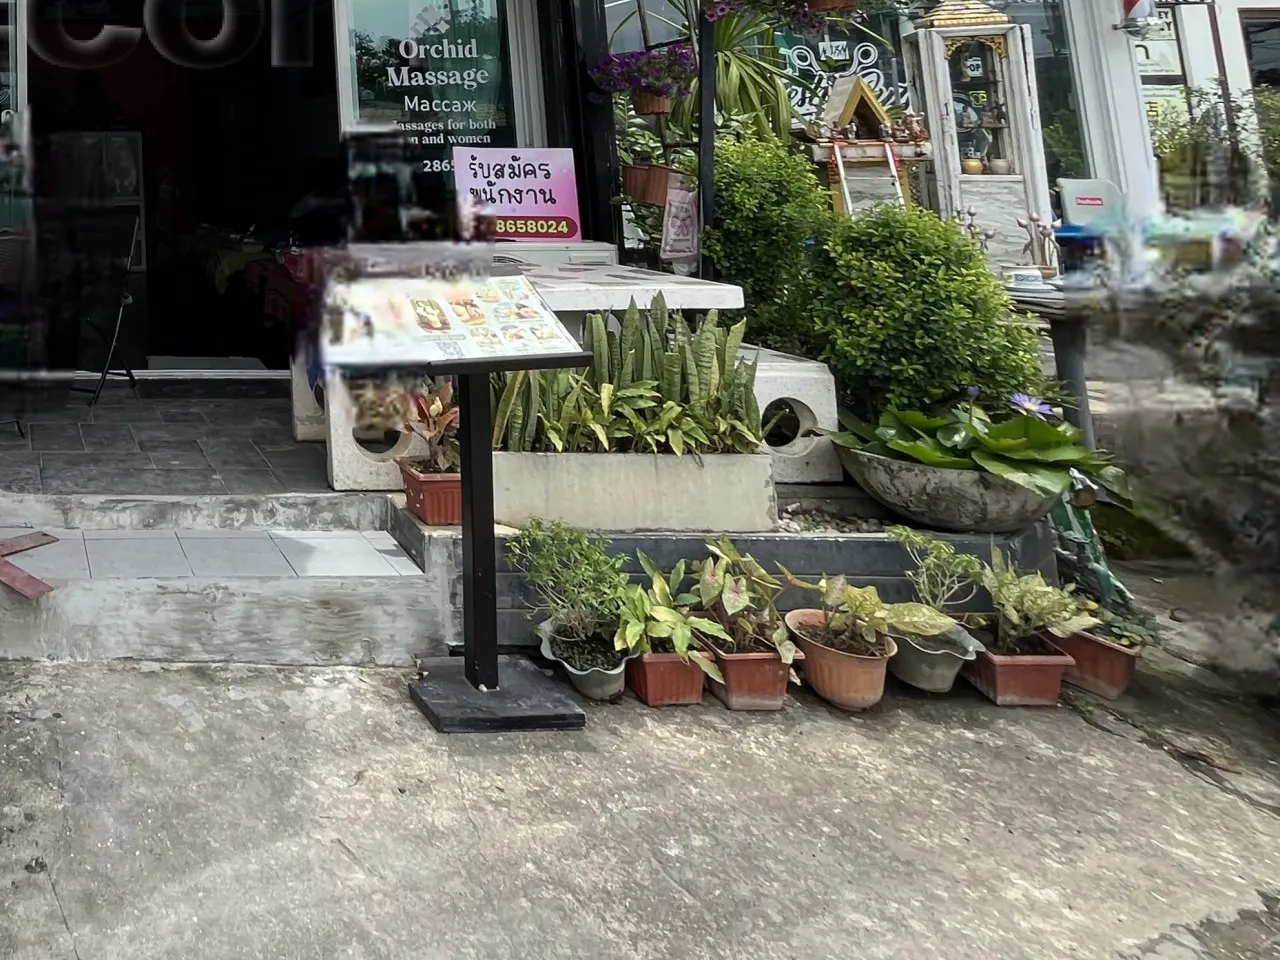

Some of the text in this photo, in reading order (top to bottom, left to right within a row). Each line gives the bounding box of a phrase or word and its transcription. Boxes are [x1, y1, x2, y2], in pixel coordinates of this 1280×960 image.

[398, 38, 478, 60] Orchid
[385, 66, 490, 91] Massage
[404, 94, 478, 113] Массаж
[393, 118, 497, 133] assages for both
[421, 133, 445, 145] and
[446, 135, 492, 145] women
[468, 154, 552, 180] รับสมัคร
[469, 180, 557, 205] พนักงาน
[495, 220, 569, 234] 8658024
